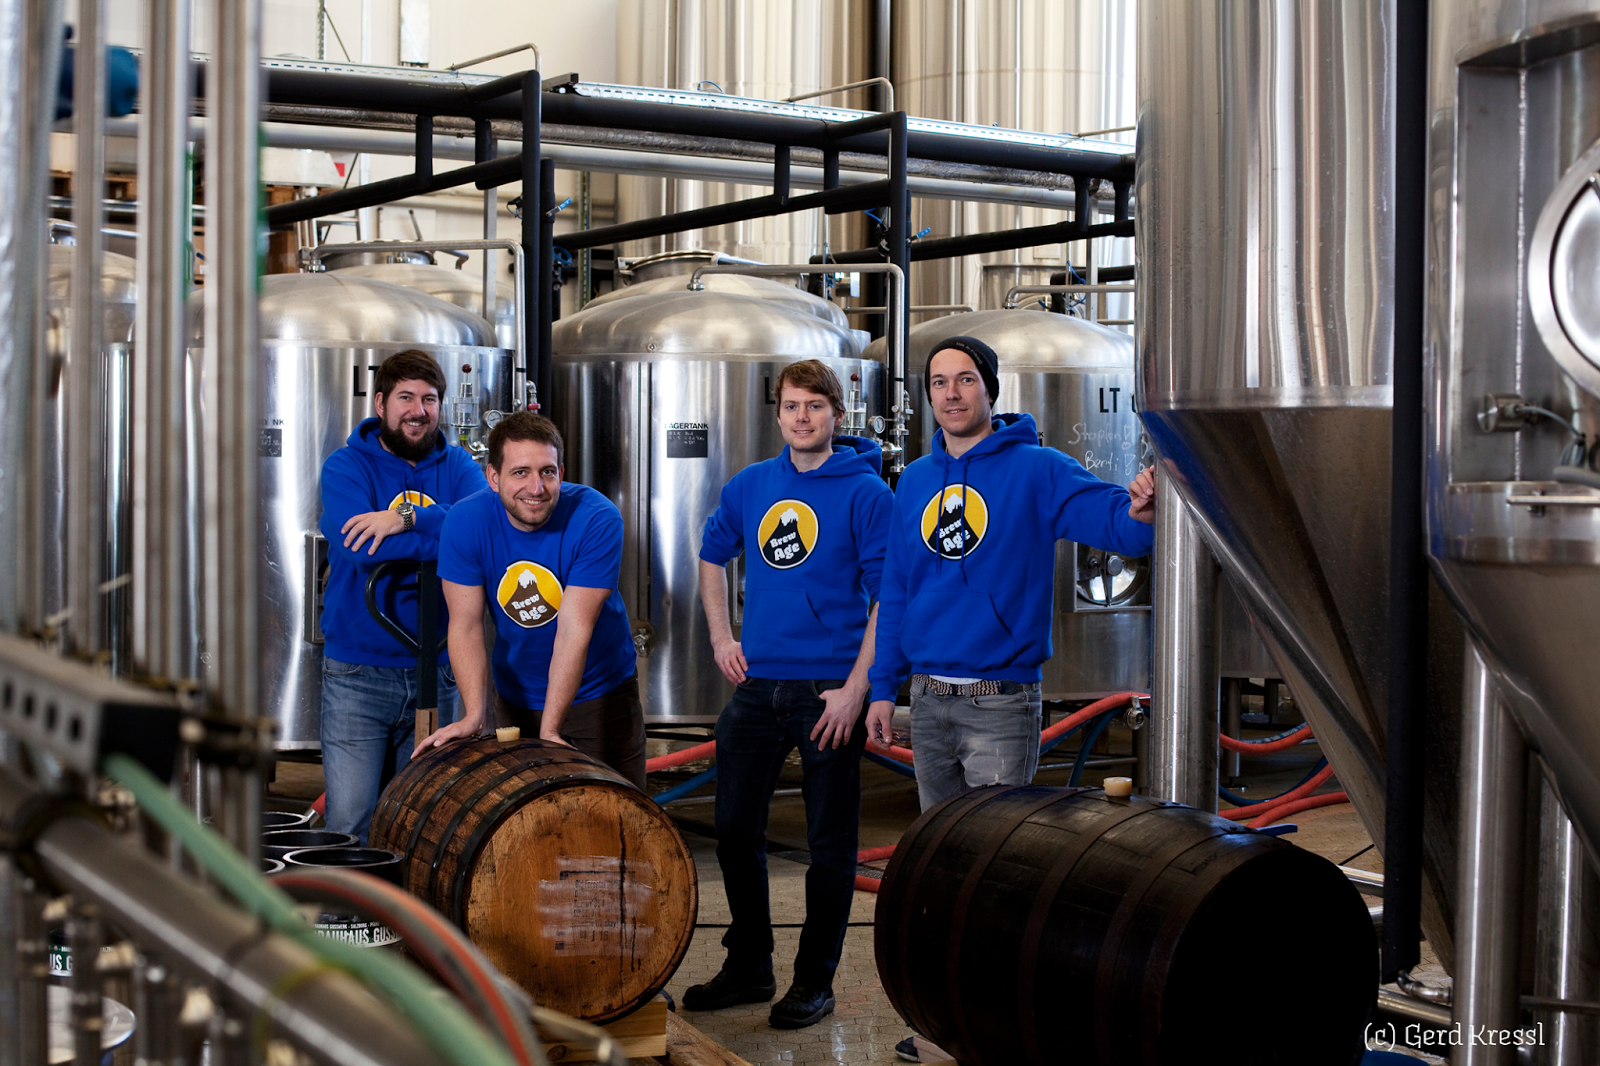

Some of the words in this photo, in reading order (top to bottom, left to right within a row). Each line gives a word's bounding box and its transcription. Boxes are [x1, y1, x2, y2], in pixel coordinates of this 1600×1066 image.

[664, 422, 709, 430] LAGERTANK
[769, 531, 797, 549] Brew
[773, 542, 800, 562] Age
[511, 593, 540, 610] Brew
[518, 604, 548, 622] Age
